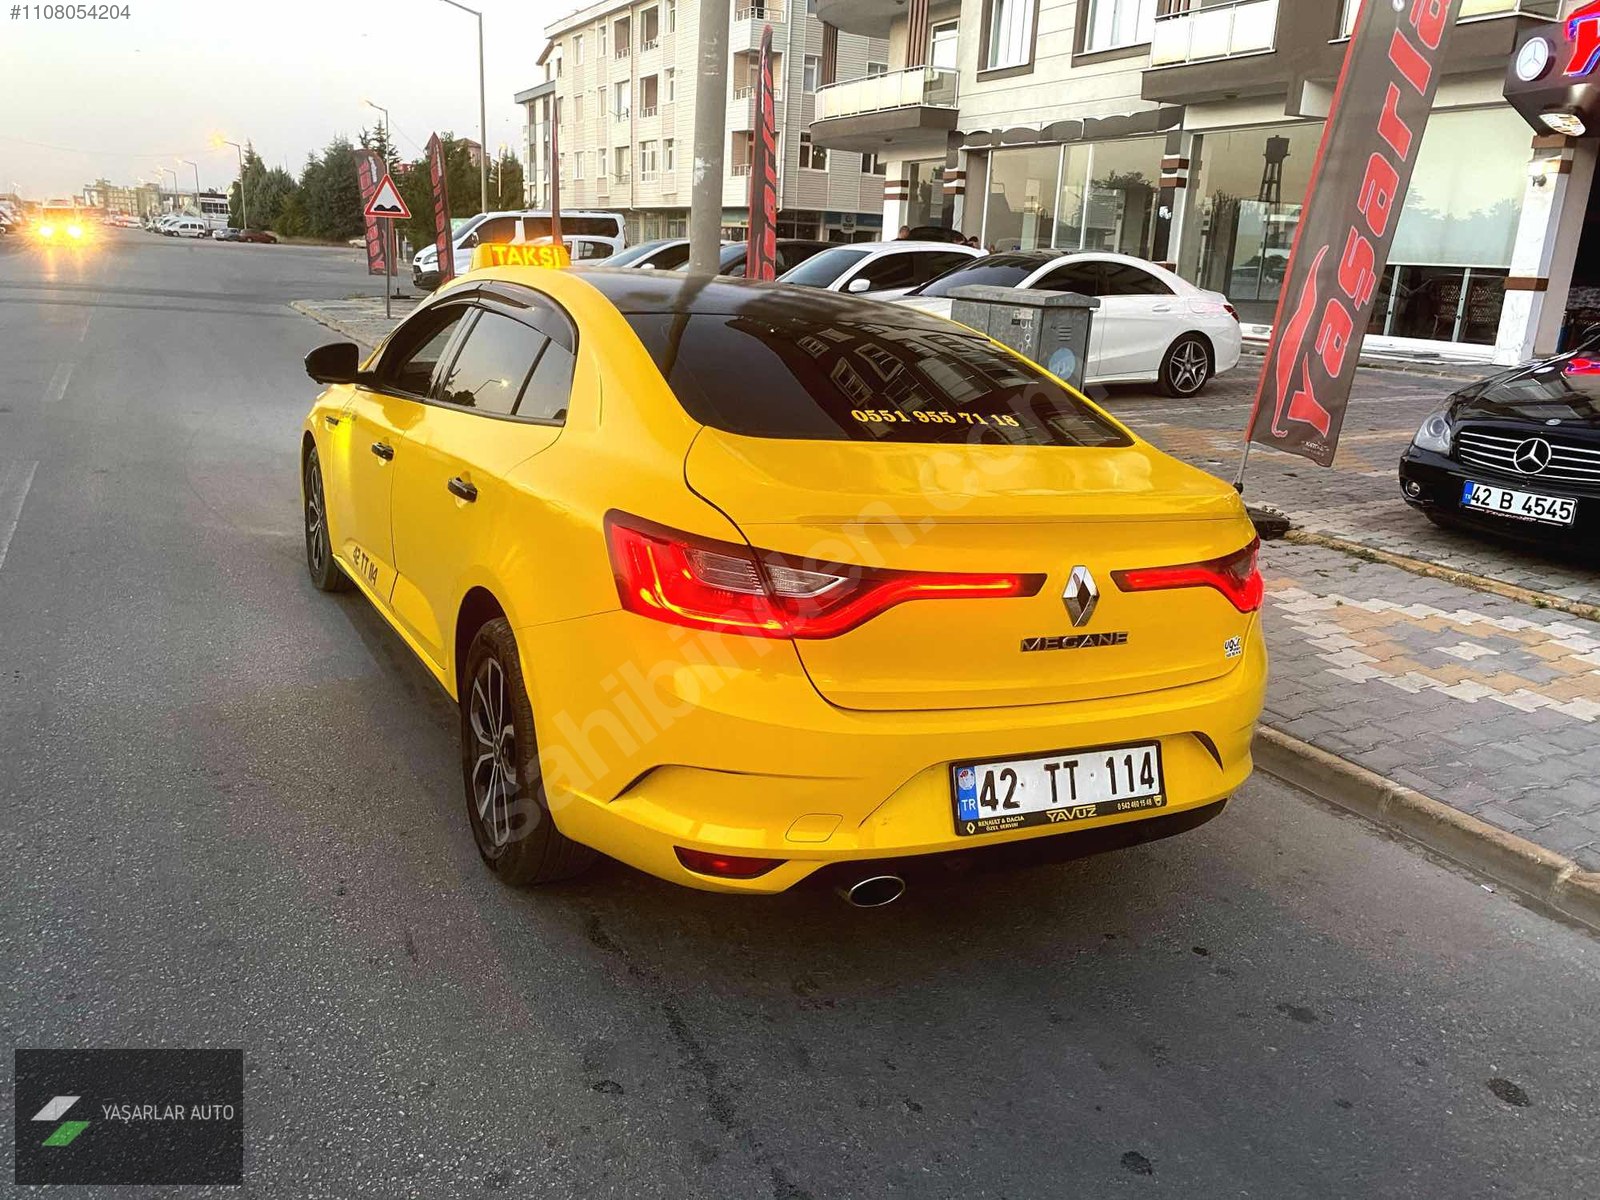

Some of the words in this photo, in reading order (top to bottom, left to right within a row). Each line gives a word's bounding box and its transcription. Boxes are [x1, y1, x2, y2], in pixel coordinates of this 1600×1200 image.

[850, 409, 911, 423] 0551
[912, 410, 957, 424] 955
[957, 412, 989, 425] 71
[990, 414, 1020, 427] 18
[1471, 486, 1492, 506] 42
[1499, 491, 1514, 510] B
[1521, 496, 1573, 520] 4545
[1020, 631, 1130, 652] MEGANE
[961, 798, 977, 812] TR
[979, 768, 1021, 812] 42
[1044, 760, 1079, 803] TT
[1106, 751, 1154, 795] 114
[1046, 804, 1097, 822] YAVUZ
